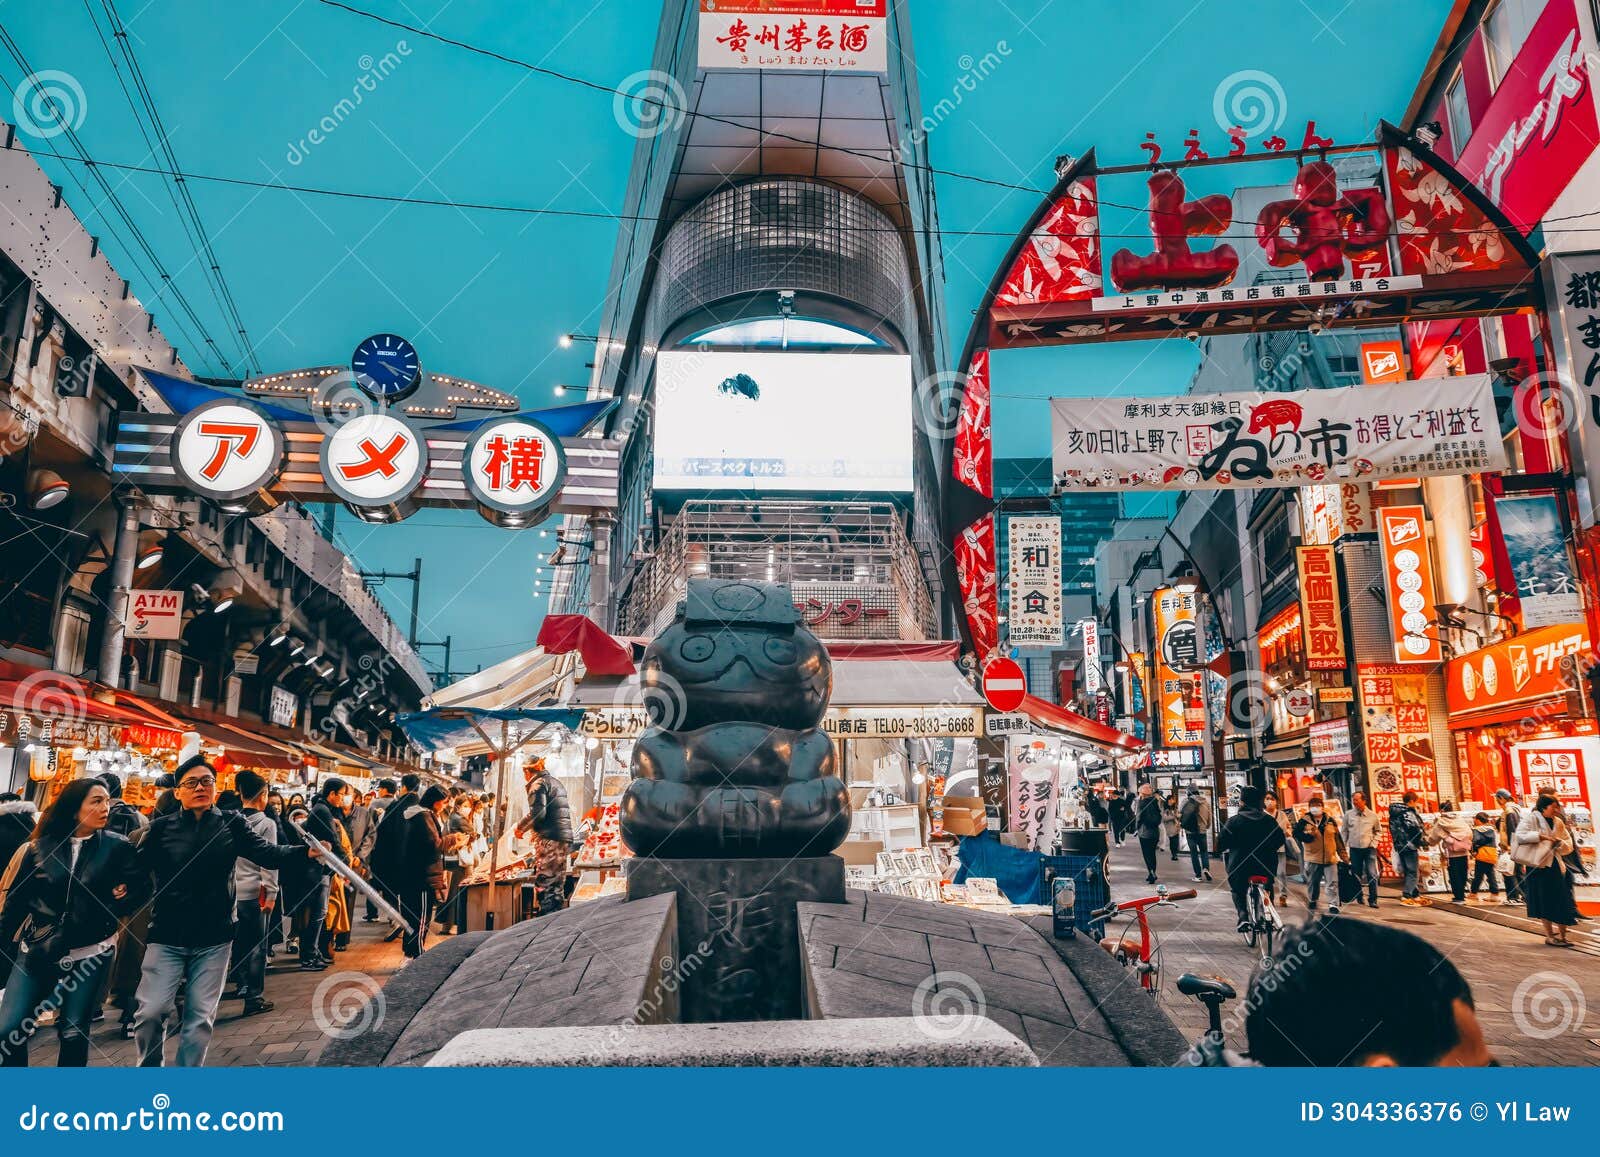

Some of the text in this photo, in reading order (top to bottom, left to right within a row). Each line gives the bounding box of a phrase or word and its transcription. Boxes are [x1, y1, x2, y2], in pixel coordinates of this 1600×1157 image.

[1110, 161, 1391, 293] 上中
[1121, 278, 1390, 308] 上野中通商店街振興組合
[1124, 400, 1241, 418] 摩利支天御縁日
[1355, 406, 1484, 443] お得とご利益を
[1068, 428, 1182, 455] 亥の日は上野で
[198, 419, 545, 493] アメ横
[1519, 572, 1577, 595] モネ
[135, 594, 177, 608] ATM
[793, 598, 889, 625] ンター
[1301, 548, 1340, 656] 高価買取
[989, 717, 1029, 731] 自転車を除く
[1398, 707, 1426, 720] ダイヤ
